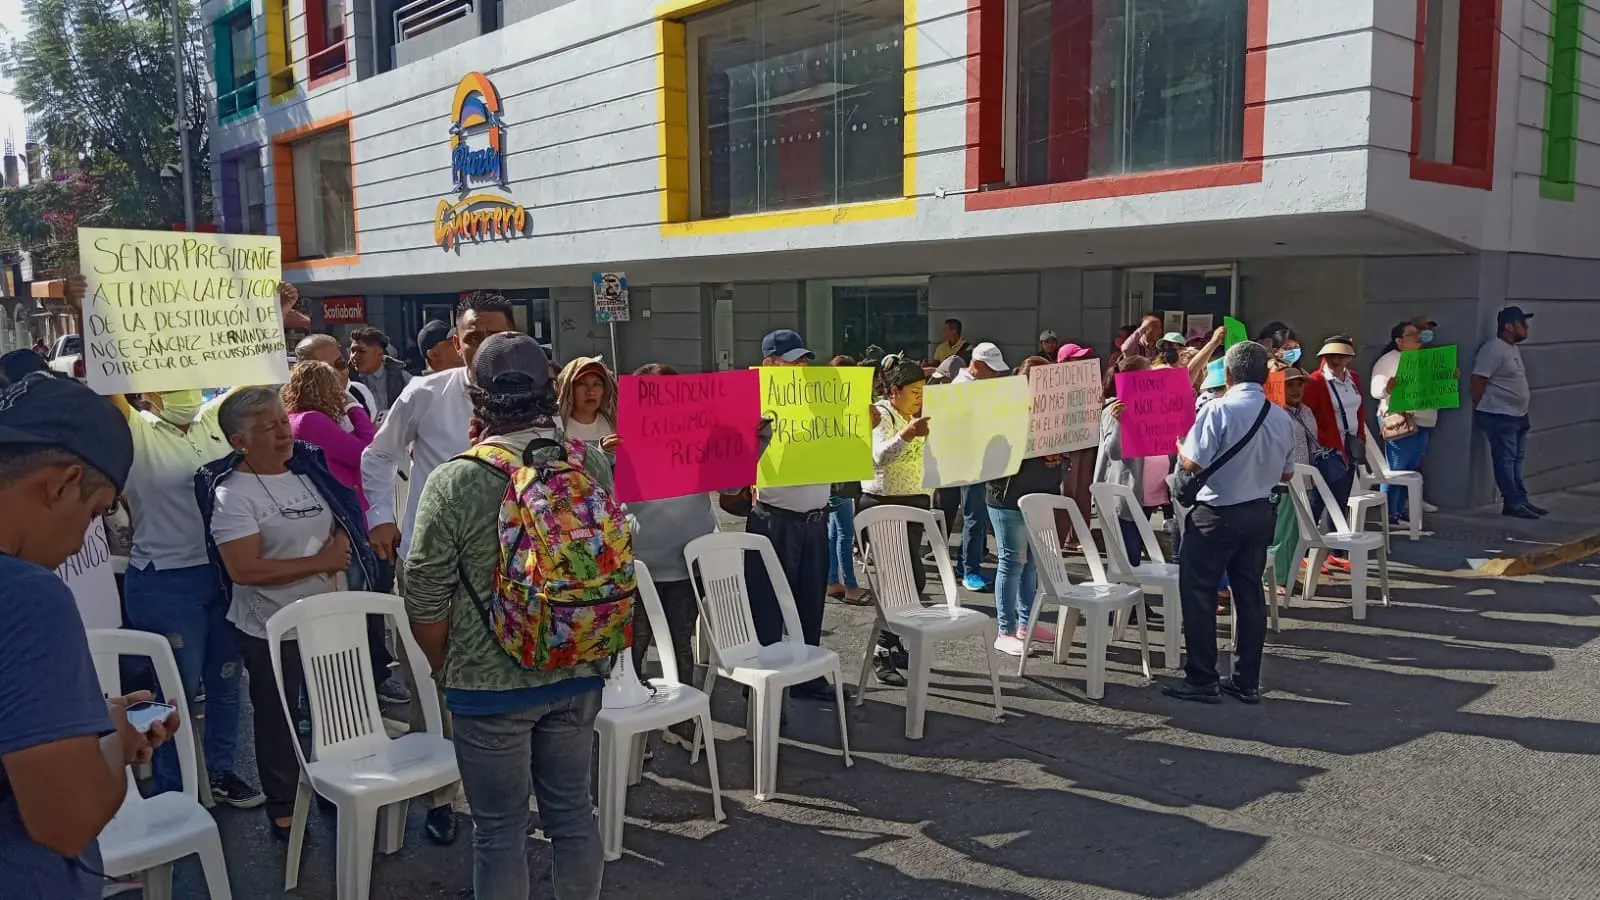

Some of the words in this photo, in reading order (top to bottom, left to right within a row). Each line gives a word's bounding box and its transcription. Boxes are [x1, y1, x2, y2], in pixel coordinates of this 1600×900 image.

[434, 200, 525, 249] Guerrero
[93, 237, 179, 274] SEÑOR
[182, 238, 278, 273] PRESIDENTE
[193, 277, 215, 302] LA
[89, 313, 115, 336] DE
[123, 312, 146, 332] LA
[153, 304, 250, 332] DESTITUCIÓN
[256, 305, 277, 325] DE
[323, 302, 362, 319] Scotiabank
[91, 338, 130, 359] NOE
[210, 328, 282, 347] HERNANDEZ
[102, 355, 177, 377] DIRECTOR
[179, 355, 198, 368] DE
[202, 344, 255, 362] RECURSOS
[638, 376, 726, 407] PRESIDENTE
[768, 370, 851, 407] Audiencia
[1034, 361, 1097, 392] PRESIDENTE
[1033, 394, 1046, 414] NO
